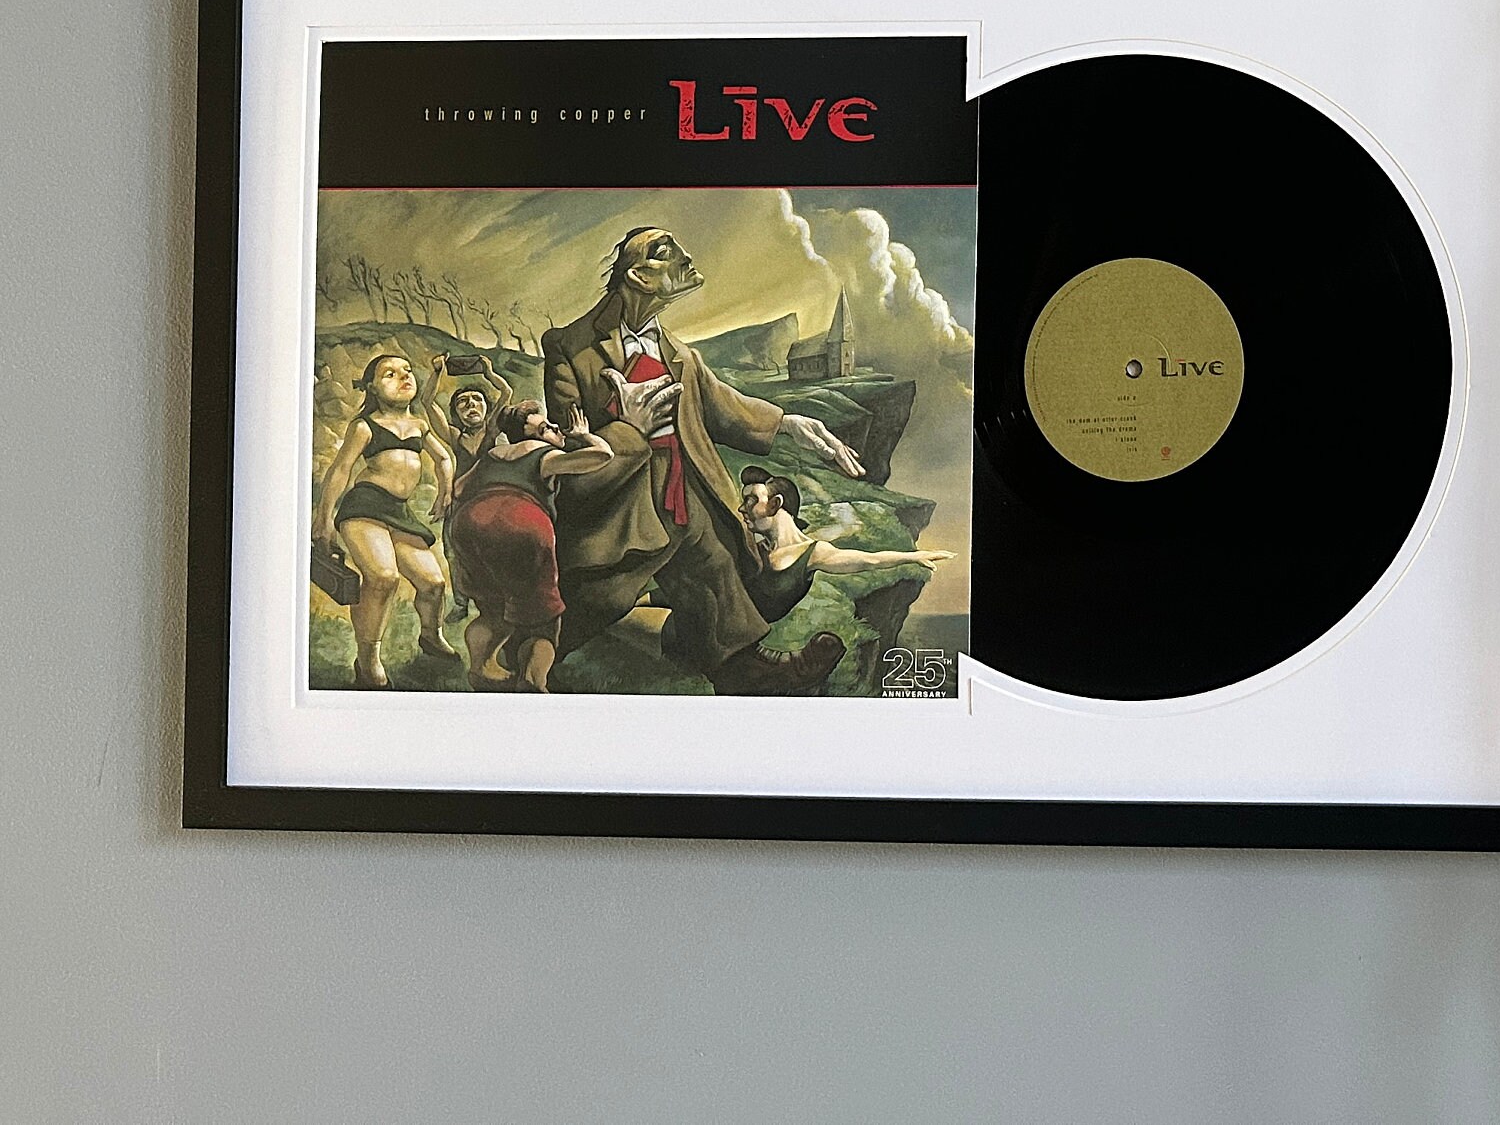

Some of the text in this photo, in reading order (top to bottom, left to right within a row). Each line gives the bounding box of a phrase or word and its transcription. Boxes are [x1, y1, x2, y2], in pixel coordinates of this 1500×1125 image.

[424, 106, 647, 124] throwing copper
[882, 690, 947, 698] ANNIVERSARY
